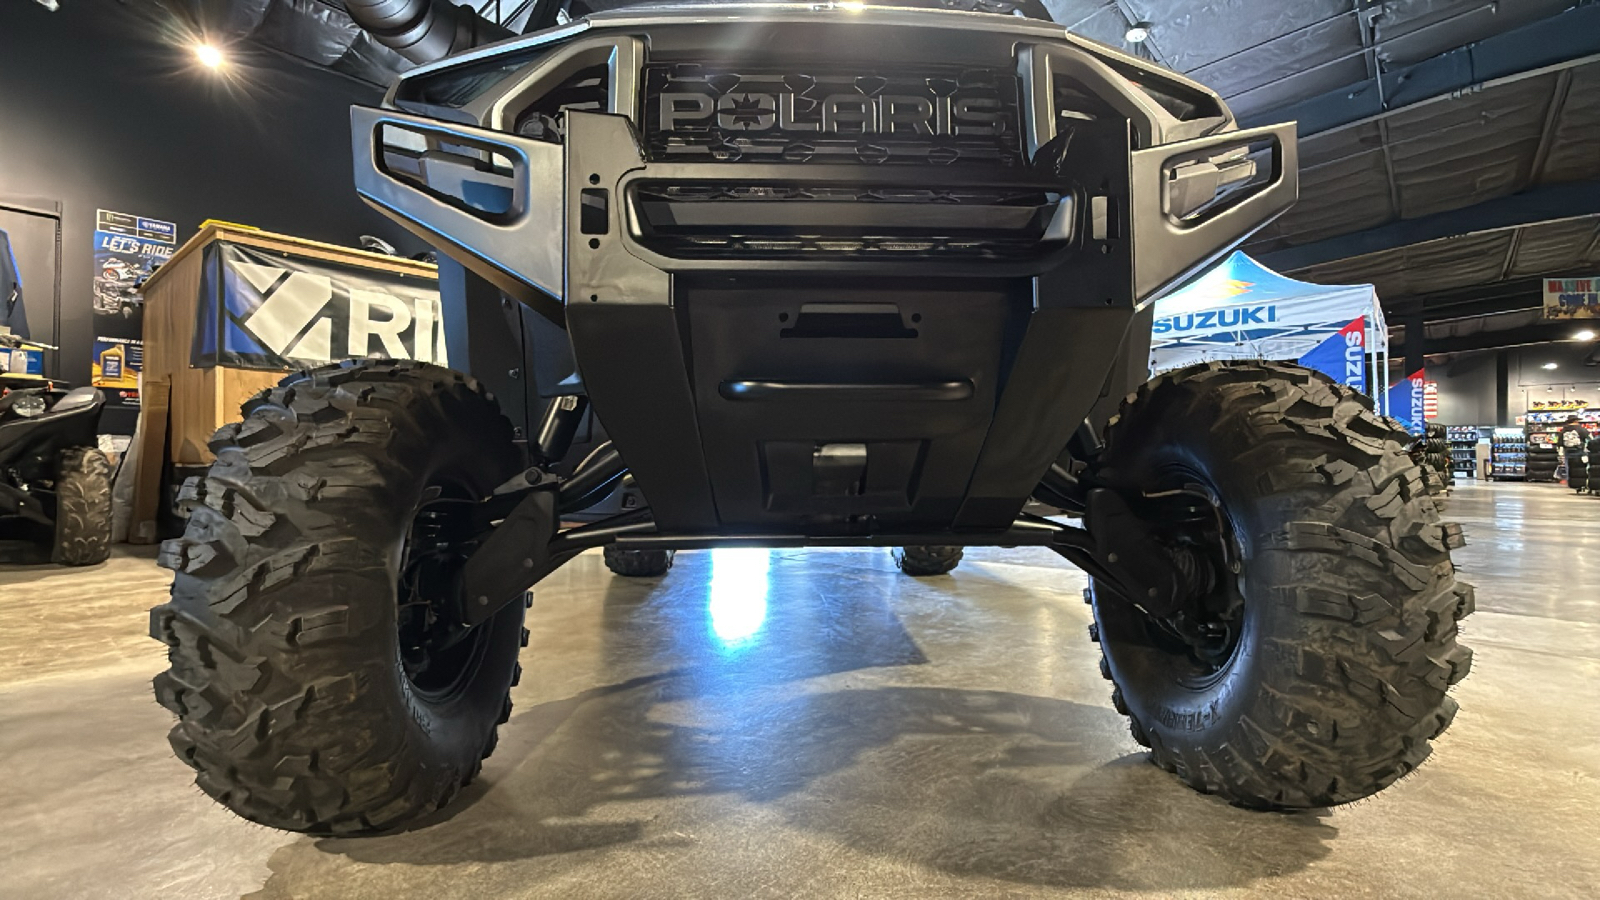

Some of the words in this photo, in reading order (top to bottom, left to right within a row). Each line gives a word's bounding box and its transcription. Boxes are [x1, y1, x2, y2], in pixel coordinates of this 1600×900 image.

[660, 92, 1006, 136] POLARIS
[102, 236, 140, 253] LET'S
[142, 243, 174, 258] RIDE
[1152, 305, 1276, 333] SUZUKI
[1411, 378, 1423, 434] SUZUKI
